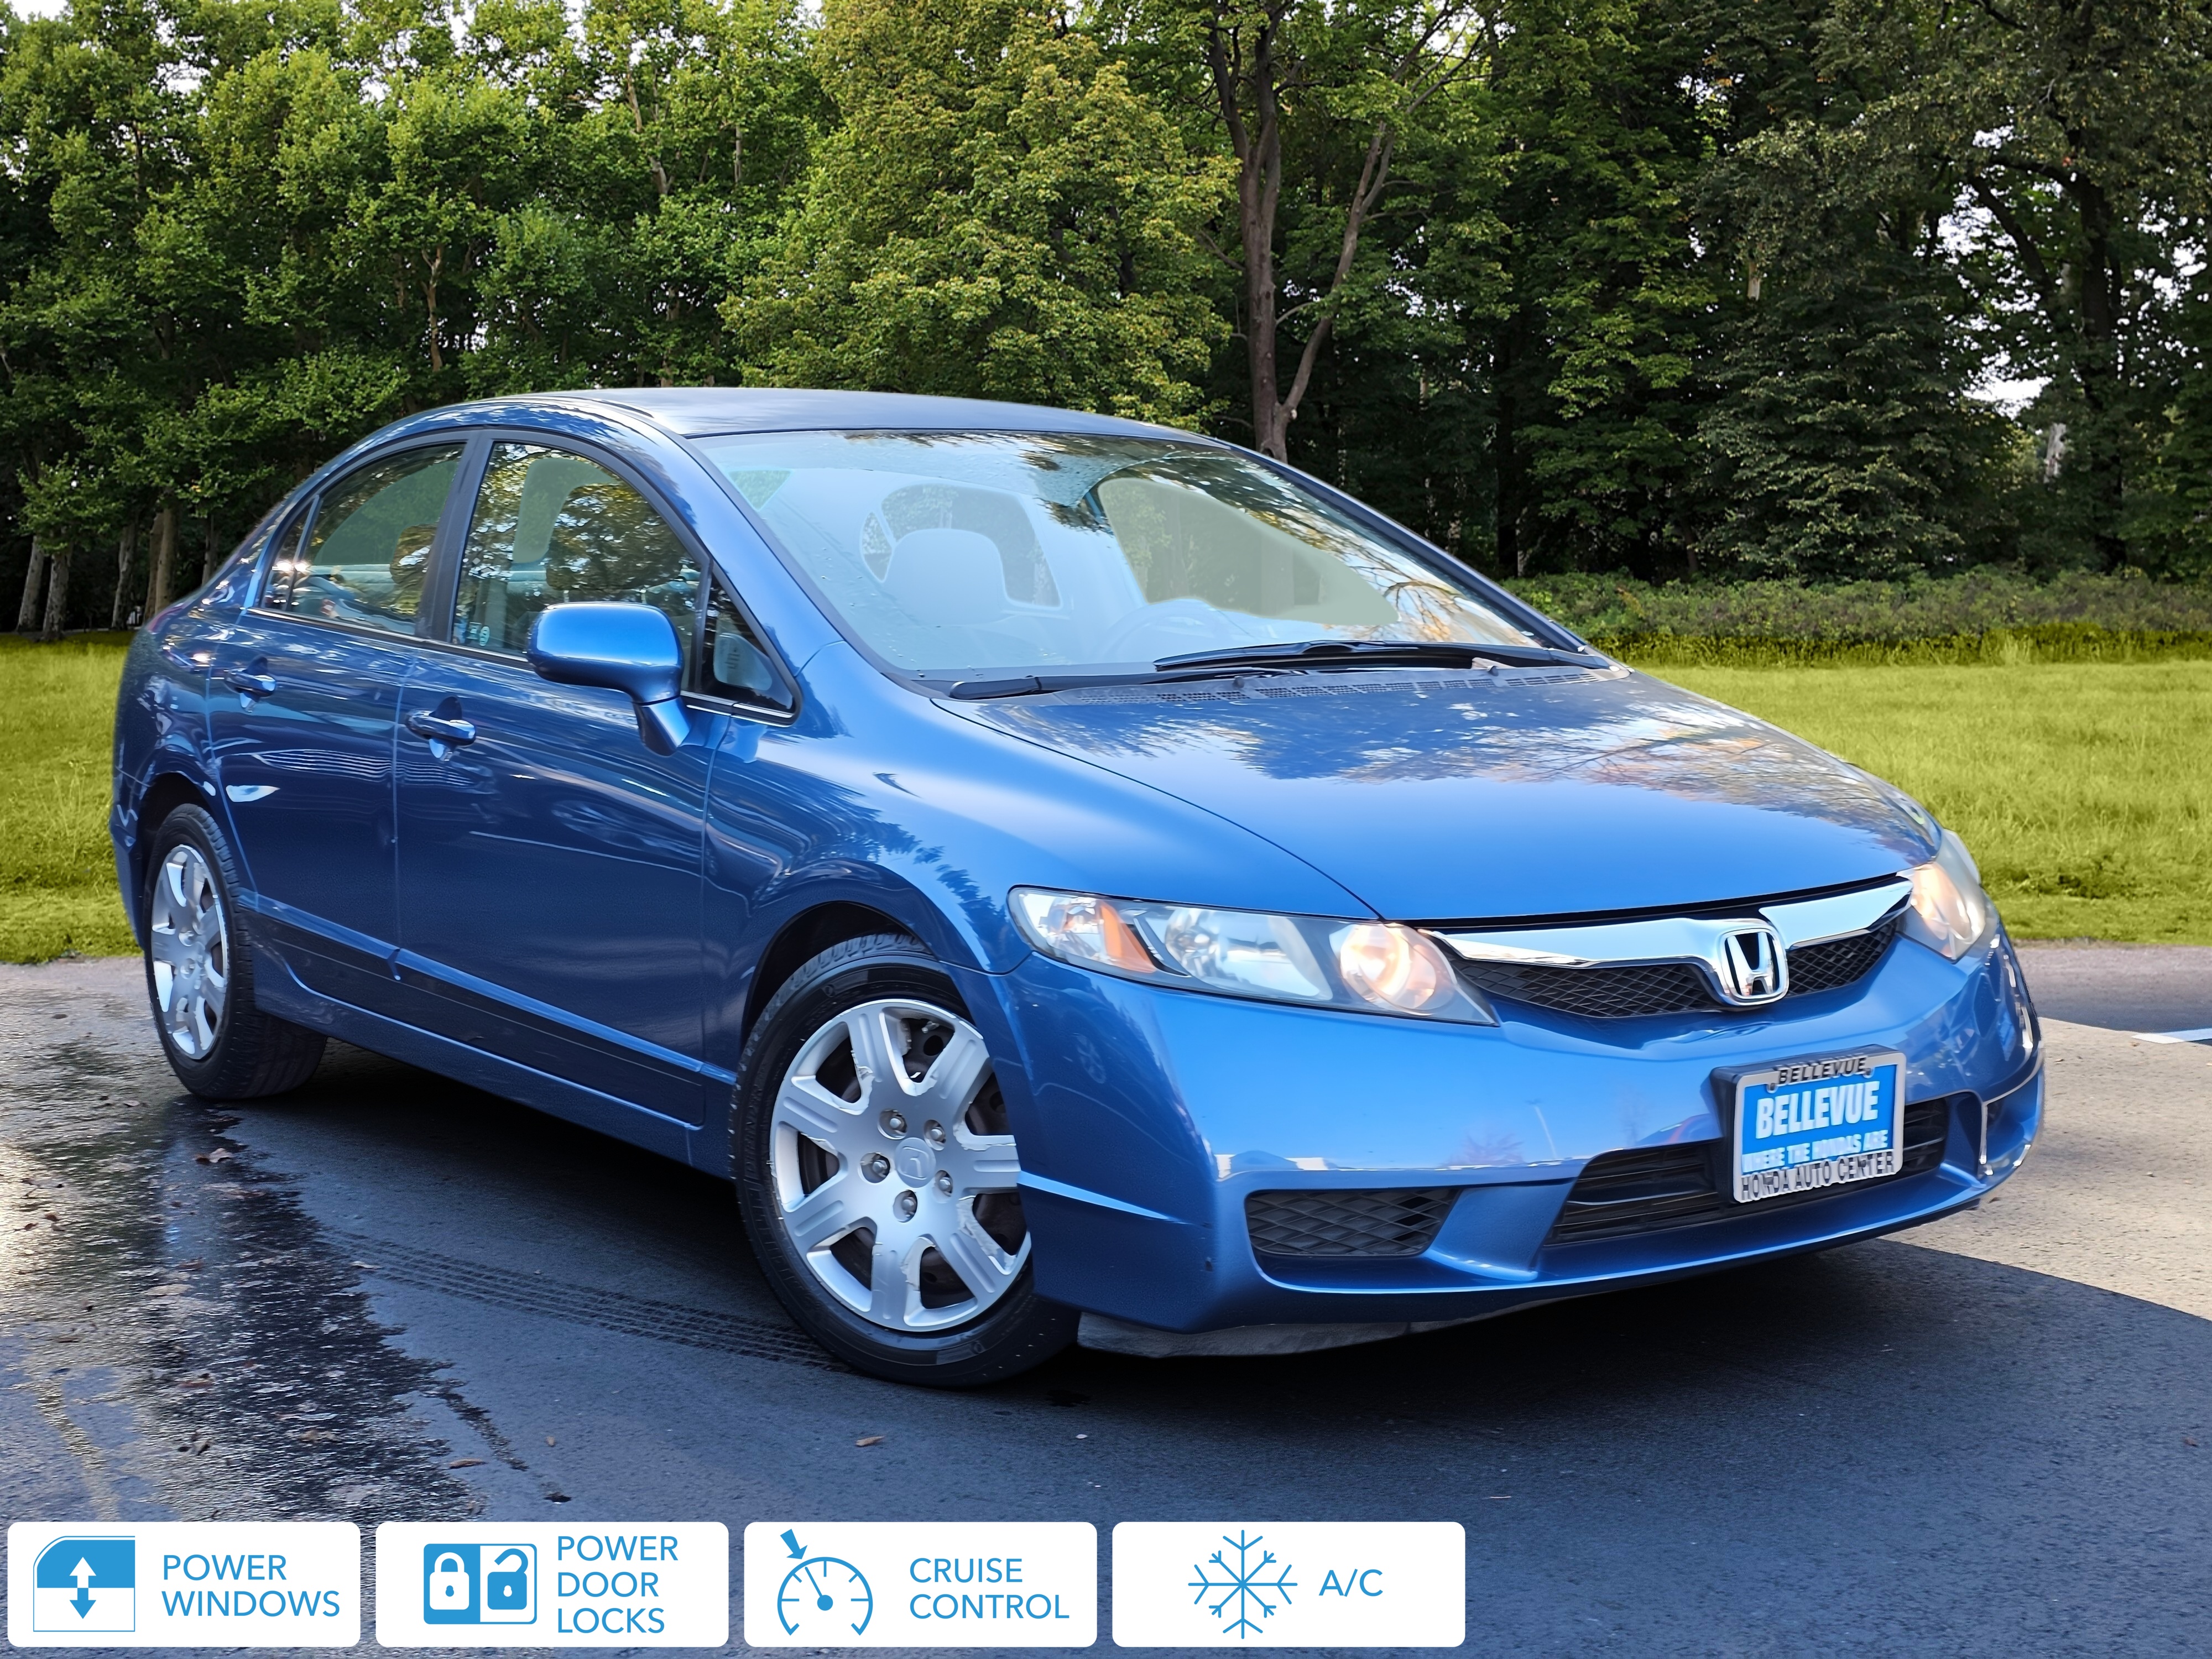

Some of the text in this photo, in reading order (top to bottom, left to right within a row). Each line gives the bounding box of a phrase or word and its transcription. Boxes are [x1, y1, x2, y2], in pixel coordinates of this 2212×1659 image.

[1778, 1057, 1867, 1084] BELLEVUE
[1756, 1081, 1880, 1139] BELLEVUE
[1741, 1151, 1894, 1201] HONDA AUTO CENTER
